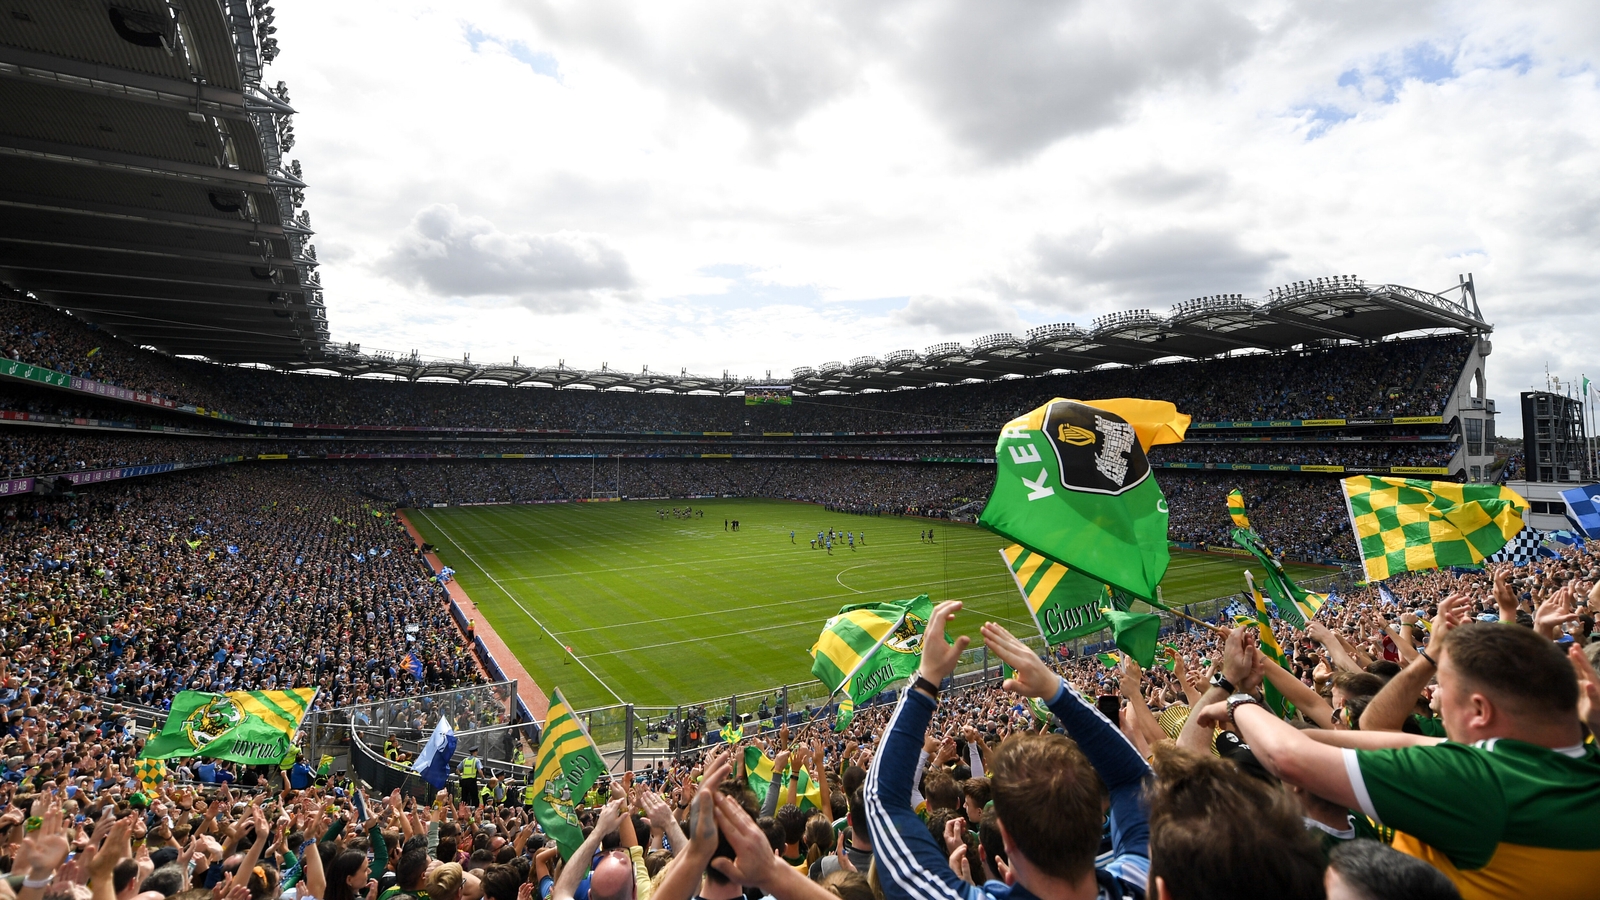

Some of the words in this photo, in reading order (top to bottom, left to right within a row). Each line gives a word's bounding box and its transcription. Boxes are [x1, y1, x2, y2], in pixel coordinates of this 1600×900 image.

[1003, 417, 1055, 501] KER
[0, 483, 8, 493] AIB
[18, 481, 27, 491] AIB
[1045, 600, 1102, 636] Ciarra
